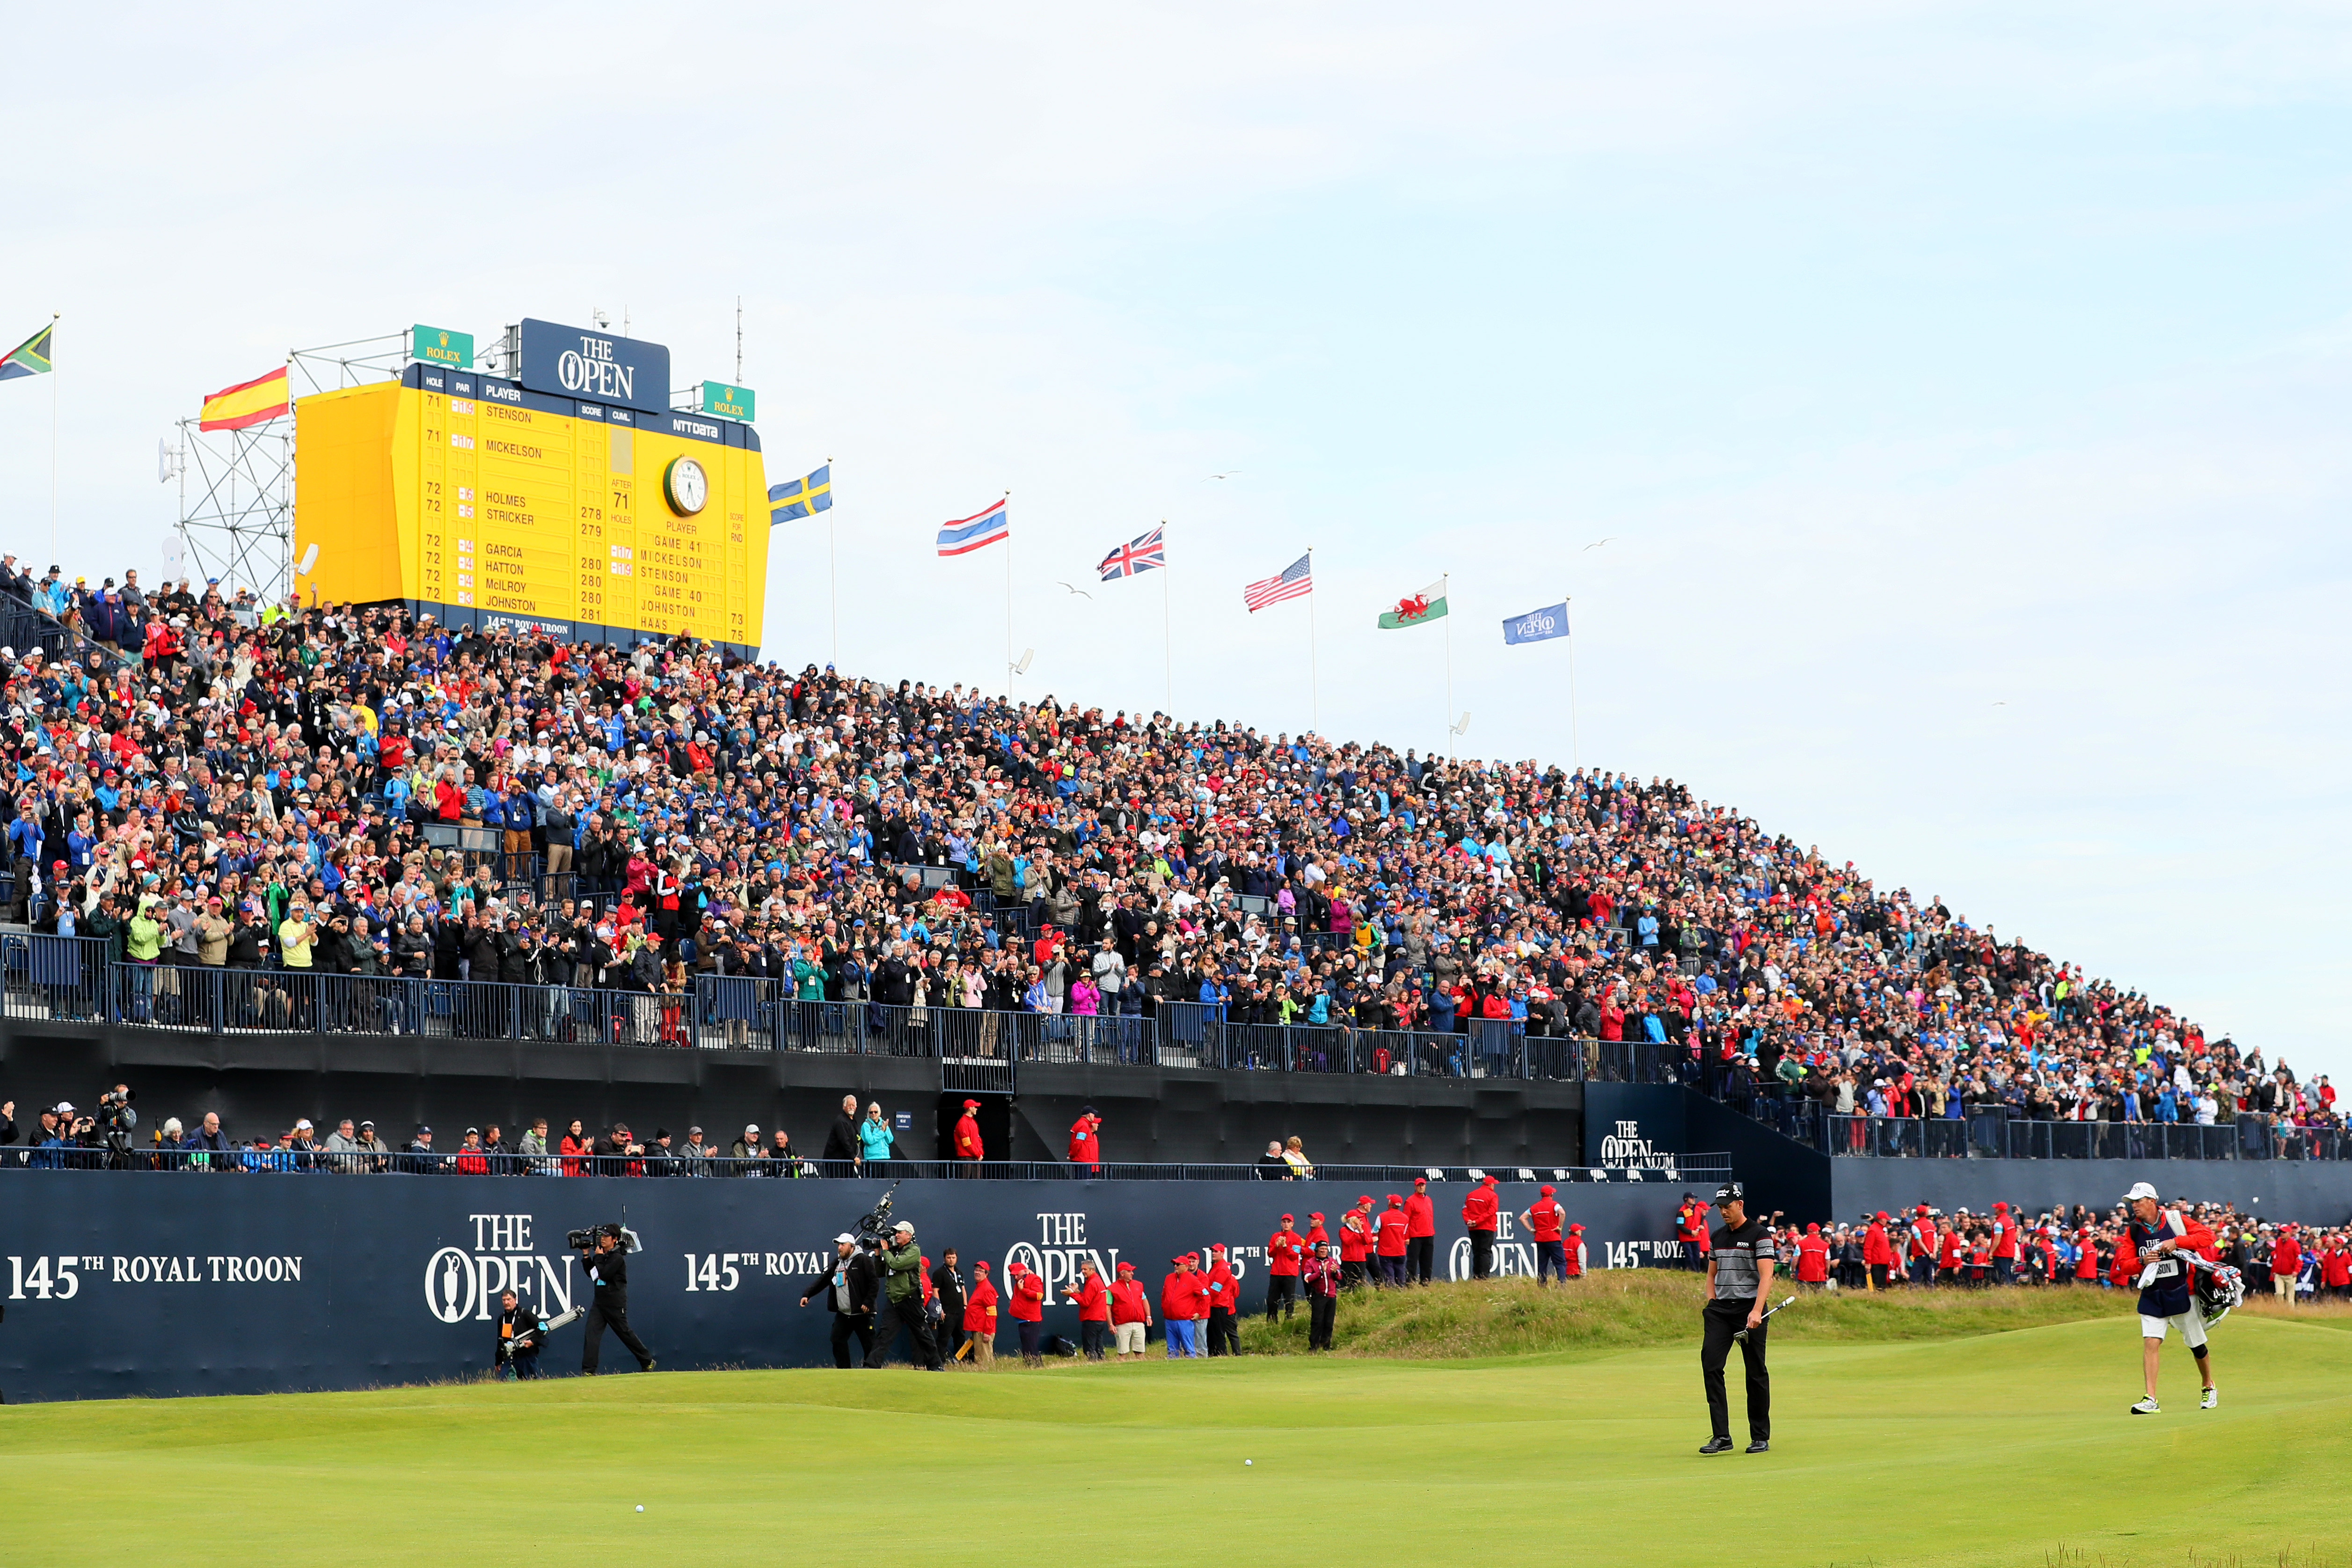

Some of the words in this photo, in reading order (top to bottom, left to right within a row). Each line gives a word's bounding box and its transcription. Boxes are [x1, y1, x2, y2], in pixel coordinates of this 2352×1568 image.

[426, 346, 461, 362] ROLEX
[580, 336, 613, 361] THE
[558, 350, 635, 400] OPEN
[426, 377, 443, 388] HOLE
[456, 382, 470, 393] PAR
[486, 385, 521, 402] PLAYER
[427, 395, 440, 408] 71
[714, 401, 744, 416] ROLEX
[487, 406, 532, 423] STENSON
[581, 405, 601, 417] SCORE
[427, 430, 440, 442] 71
[486, 440, 541, 459] MICKELSON
[427, 482, 440, 495] 72
[612, 479, 632, 489] AFTER
[427, 499, 440, 512] 72
[486, 491, 526, 508] HOLMES
[613, 492, 628, 509] 71
[487, 509, 534, 525] STRICKER
[581, 507, 601, 520] 278
[611, 514, 632, 524] HOLES
[730, 512, 744, 521] SCORE
[581, 524, 601, 537] 279
[666, 521, 697, 535] PLAYER
[733, 523, 741, 531] FOR
[427, 534, 440, 547] 72
[655, 535, 681, 549] GAME
[689, 541, 701, 553] 41
[731, 533, 743, 542] RND
[427, 552, 440, 564] 72
[486, 544, 523, 558] GARCIA
[581, 557, 601, 570] 280
[641, 550, 701, 569] MICKELSON
[426, 569, 440, 582] 72
[486, 561, 523, 576] HATTON
[641, 567, 688, 583] STENSON
[486, 578, 526, 593] McILROY
[581, 575, 601, 587] 280
[426, 587, 440, 599] 72
[581, 591, 601, 604] 280
[655, 585, 681, 598] GAME
[690, 591, 701, 602] 40
[486, 596, 535, 612] JOHNSTON
[641, 599, 695, 617] JOHNSTON
[581, 608, 600, 621] 281
[731, 613, 743, 625] 73
[541, 623, 568, 634] TROON
[641, 618, 667, 630] HAAS
[731, 630, 743, 642] 75
[1615, 1120, 1638, 1138] THE
[469, 1214, 534, 1252] THE
[1037, 1213, 1087, 1246] THE
[1605, 1241, 1651, 1270] 145TH
[7, 1255, 104, 1300] 145TH
[112, 1255, 201, 1283] ROYAL
[207, 1255, 302, 1283] TROON
[684, 1252, 759, 1292] 145TH
[424, 1247, 575, 1324] OPEN
